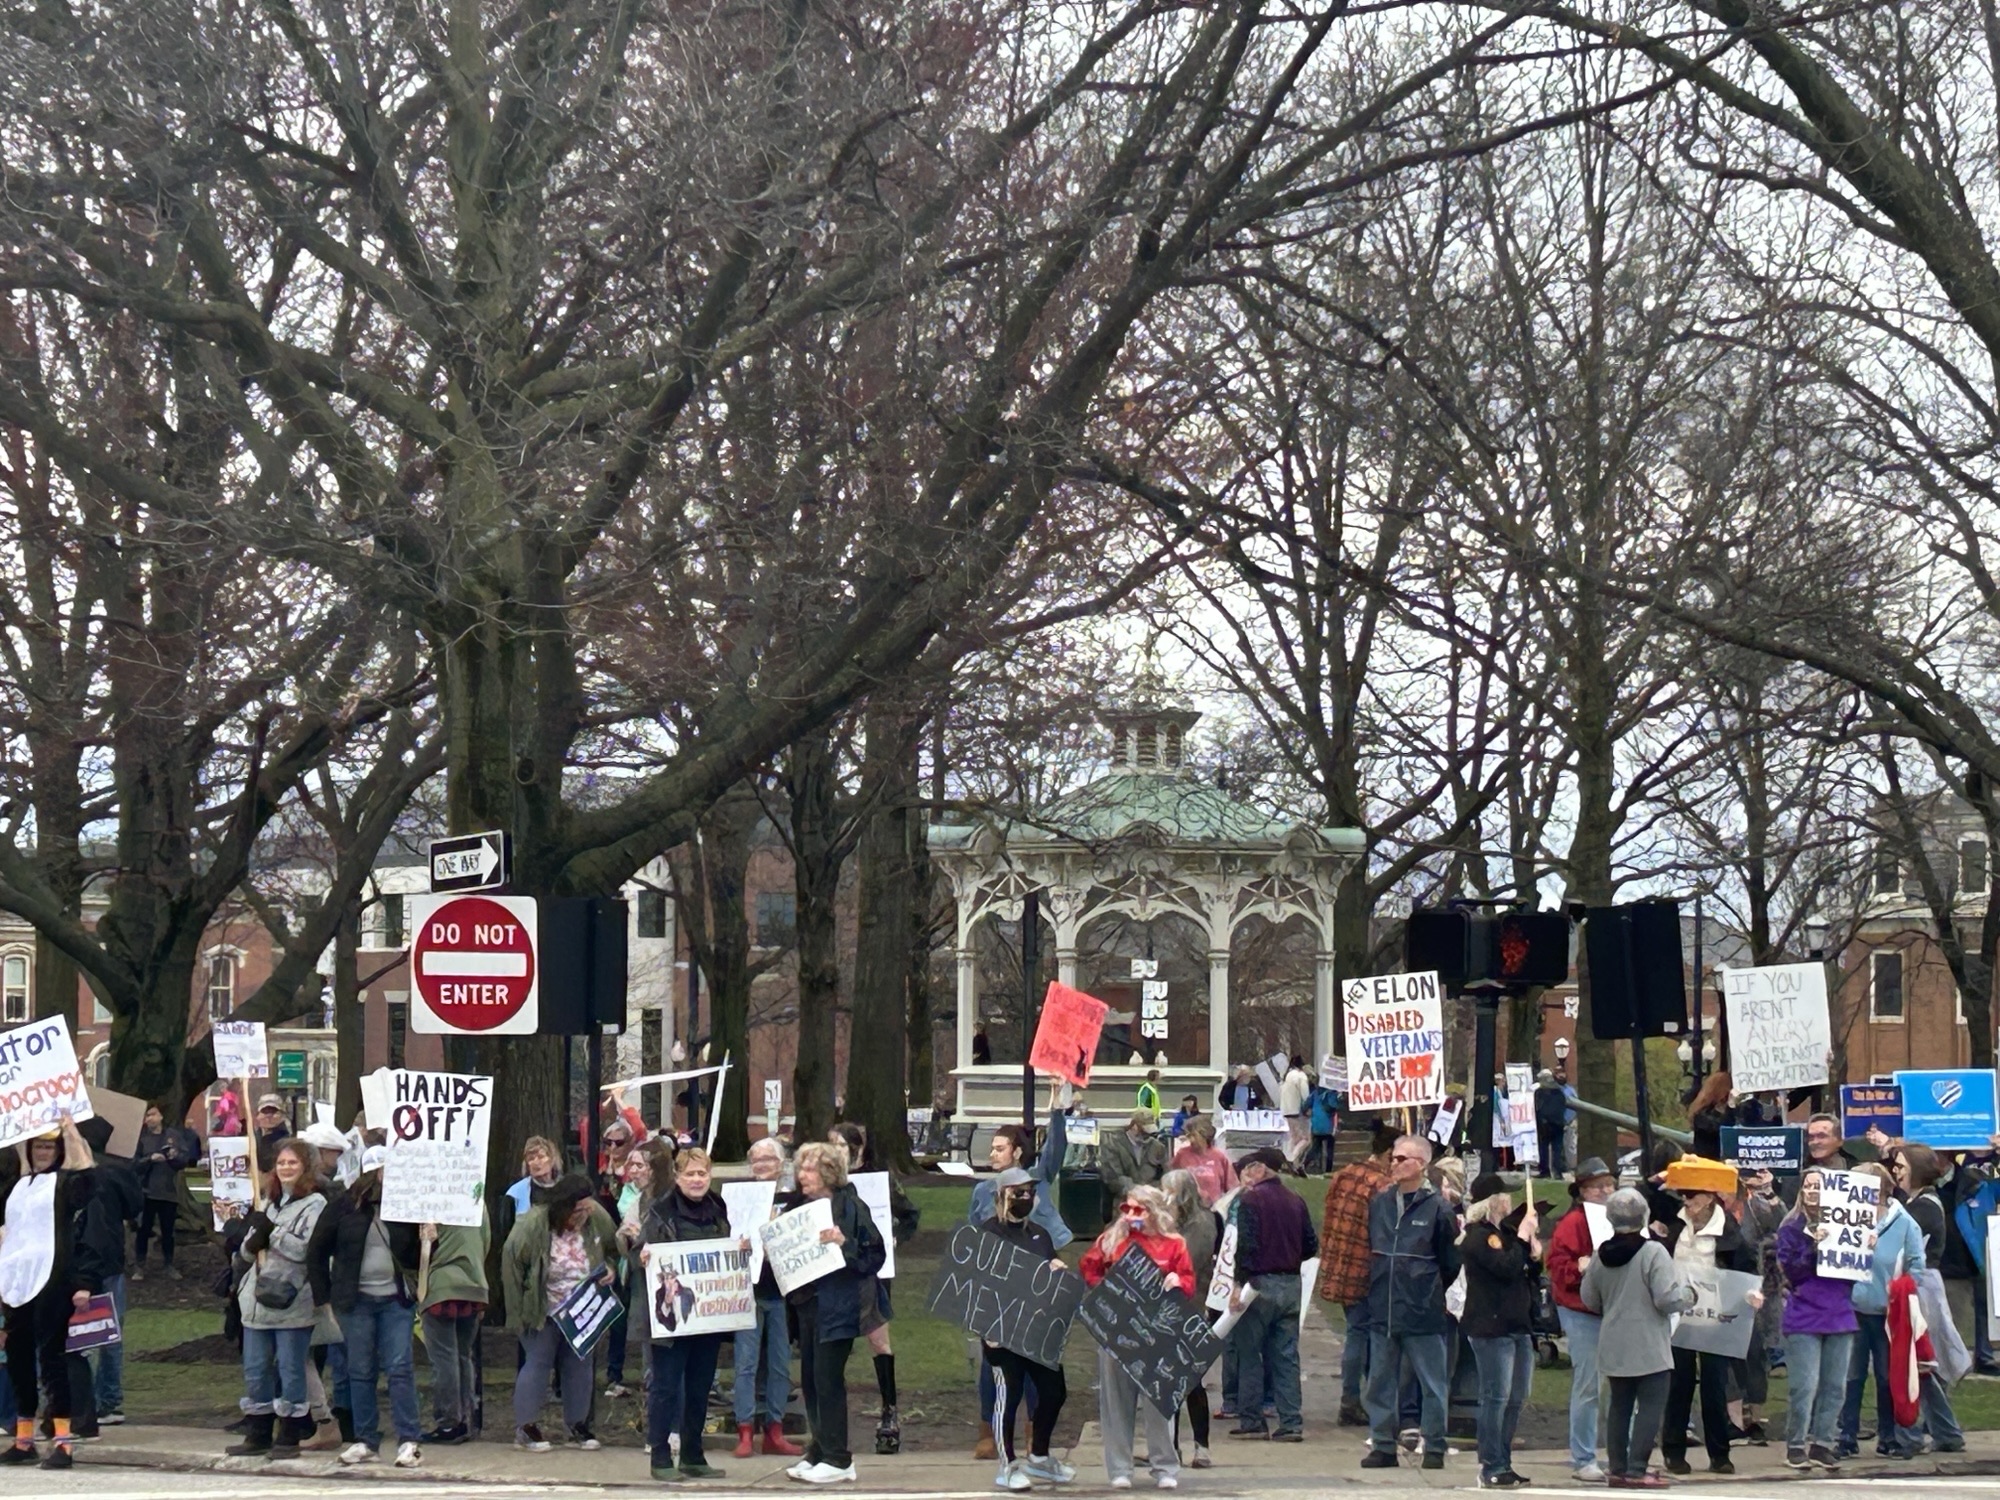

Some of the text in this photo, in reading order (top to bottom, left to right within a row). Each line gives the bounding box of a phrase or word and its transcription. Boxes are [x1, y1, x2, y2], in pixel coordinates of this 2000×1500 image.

[432, 923, 517, 945] DO NOT
[440, 983, 509, 1005] ENTER
[1373, 974, 1435, 1004] ELON
[1730, 971, 1802, 995] IF YOU
[1348, 1009, 1424, 1035] DISABLED
[1360, 1031, 1442, 1058] VETERANS
[1359, 1059, 1396, 1082] ARE
[1400, 1053, 1435, 1078] NOT
[395, 1073, 488, 1107] HANDS
[1351, 1067, 1442, 1105] ROADKILL!
[393, 1103, 477, 1147] OFF!
[1821, 1172, 1850, 1192] WE
[1847, 1185, 1880, 1206] ARE
[1819, 1206, 1876, 1230] EQUAL
[1838, 1227, 1863, 1247] AS
[680, 1249, 753, 1275] I WANT YOU
[951, 1225, 1078, 1306] GULF OF
[1119, 1244, 1165, 1301] HANDS
[931, 1273, 1067, 1363] MEXICO
